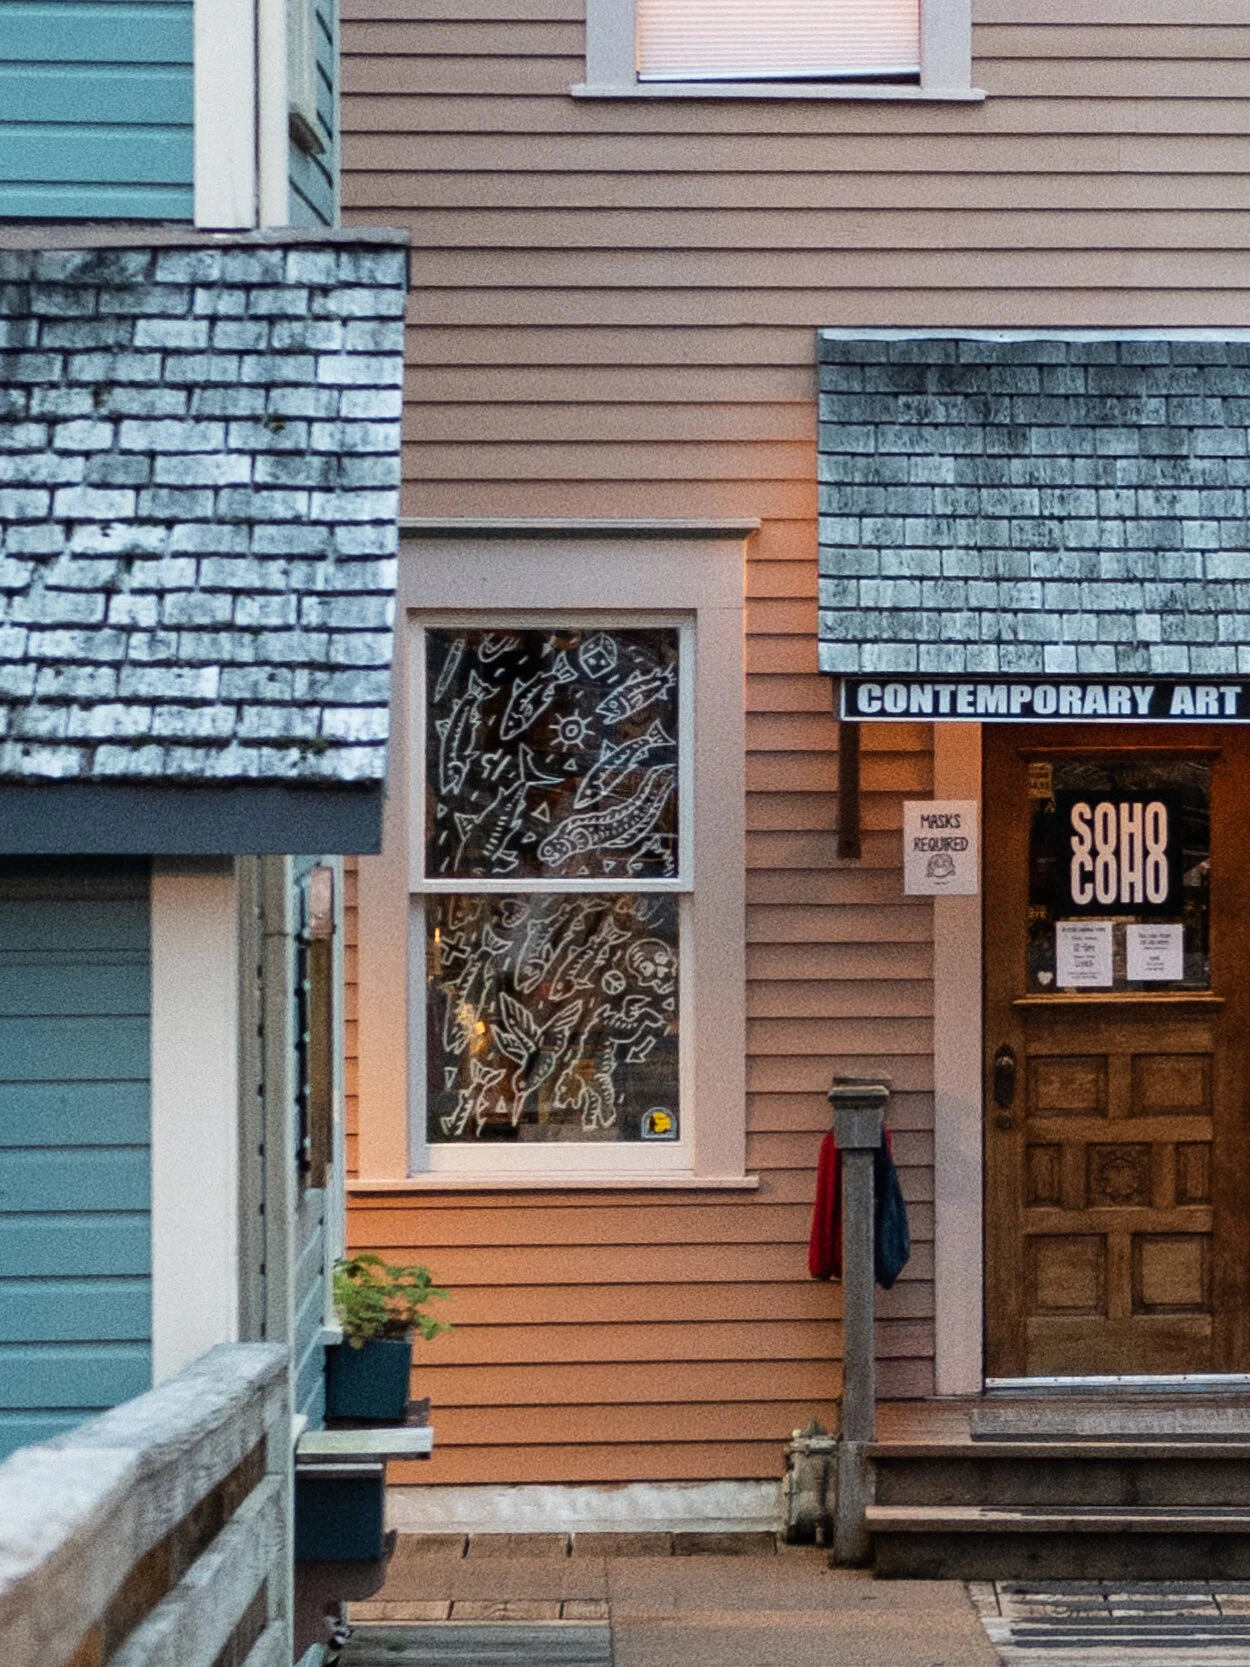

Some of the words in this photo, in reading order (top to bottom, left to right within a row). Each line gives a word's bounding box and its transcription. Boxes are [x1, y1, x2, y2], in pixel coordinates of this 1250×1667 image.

[856, 683, 1156, 716] CONTEMPORARY
[1169, 685, 1242, 716] ART
[920, 813, 961, 829] MASKS
[1070, 801, 1168, 853] SOHO
[912, 836, 969, 852] REQUIRED
[1070, 852, 1169, 905] COHO
